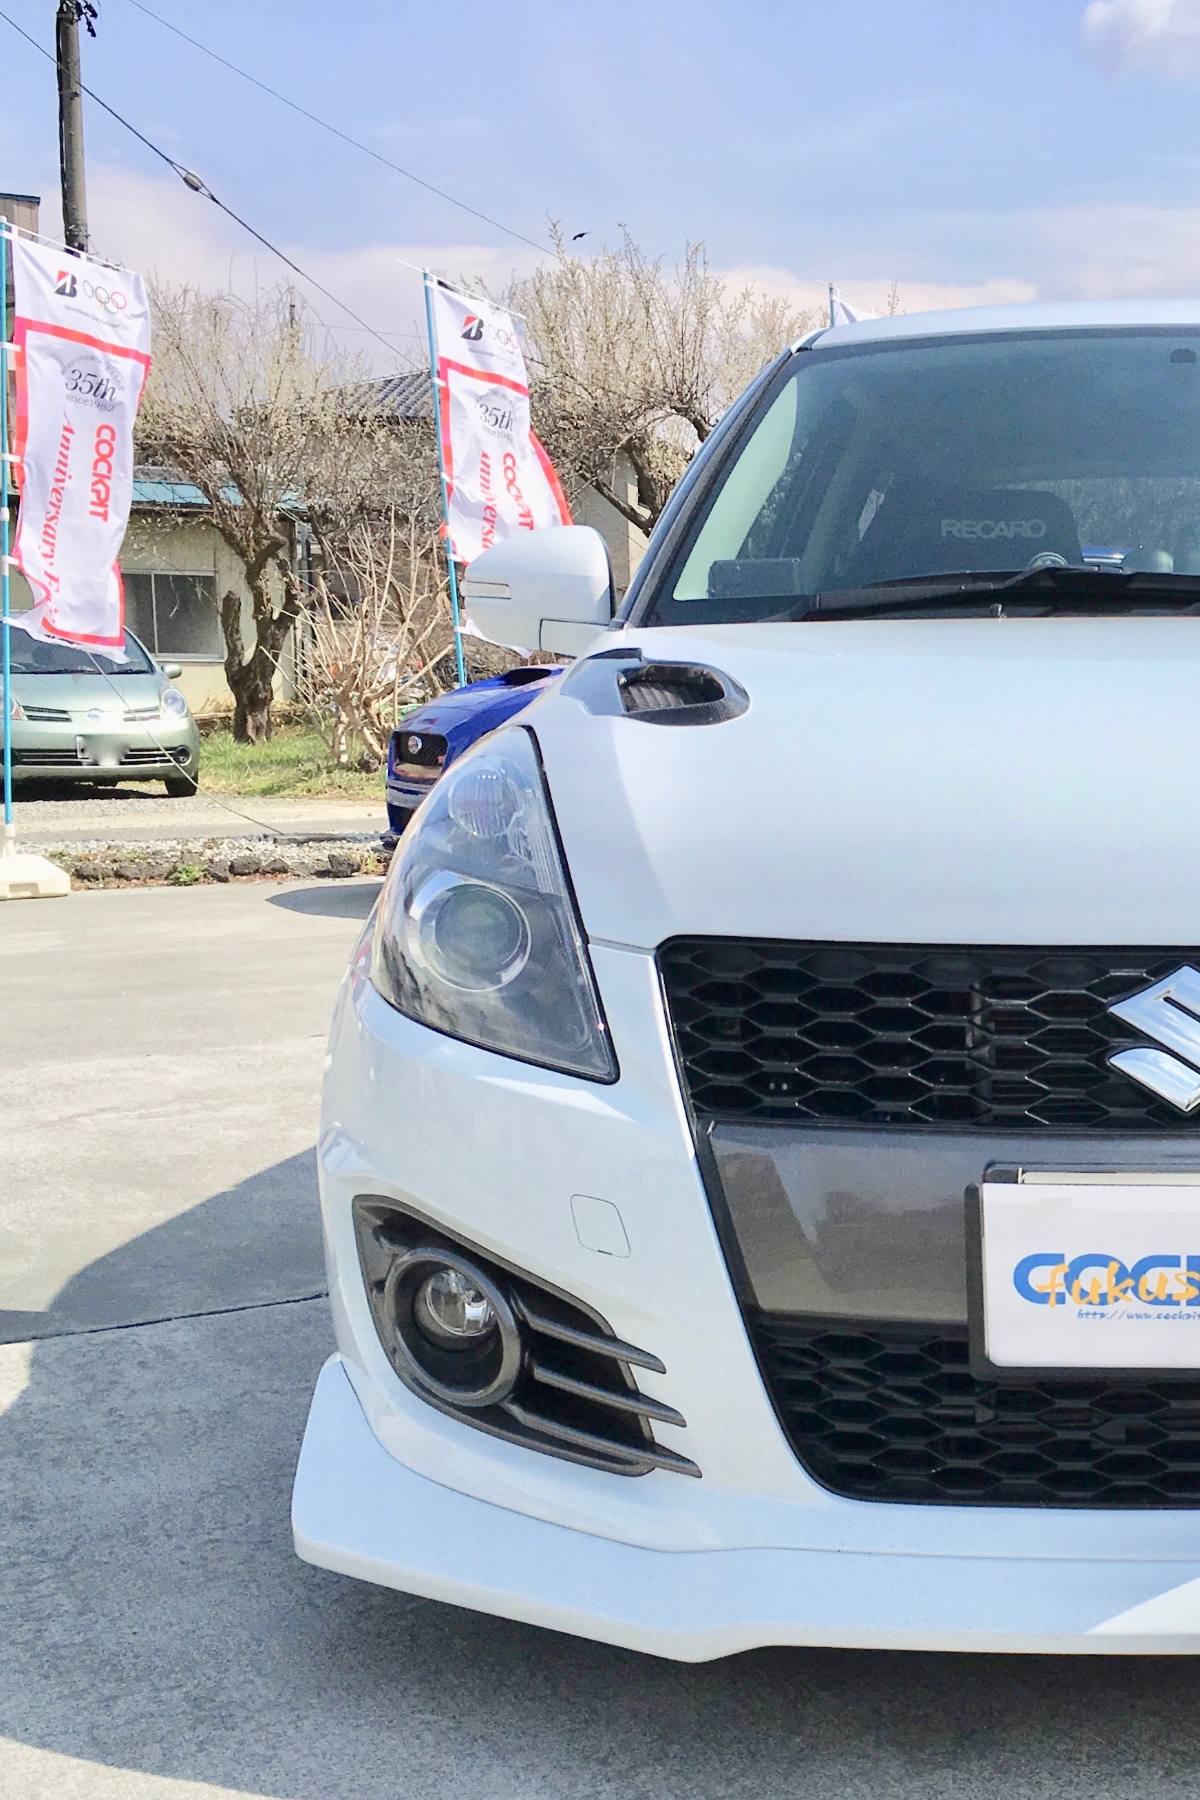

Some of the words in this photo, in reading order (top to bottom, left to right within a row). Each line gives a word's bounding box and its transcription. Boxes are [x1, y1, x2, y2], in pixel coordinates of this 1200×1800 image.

[65, 369, 117, 402] 35th
[65, 394, 115, 413] since1982
[479, 403, 514, 432] 35th
[89, 424, 116, 522] COCKPIT
[941, 519, 1047, 539] RECARO
